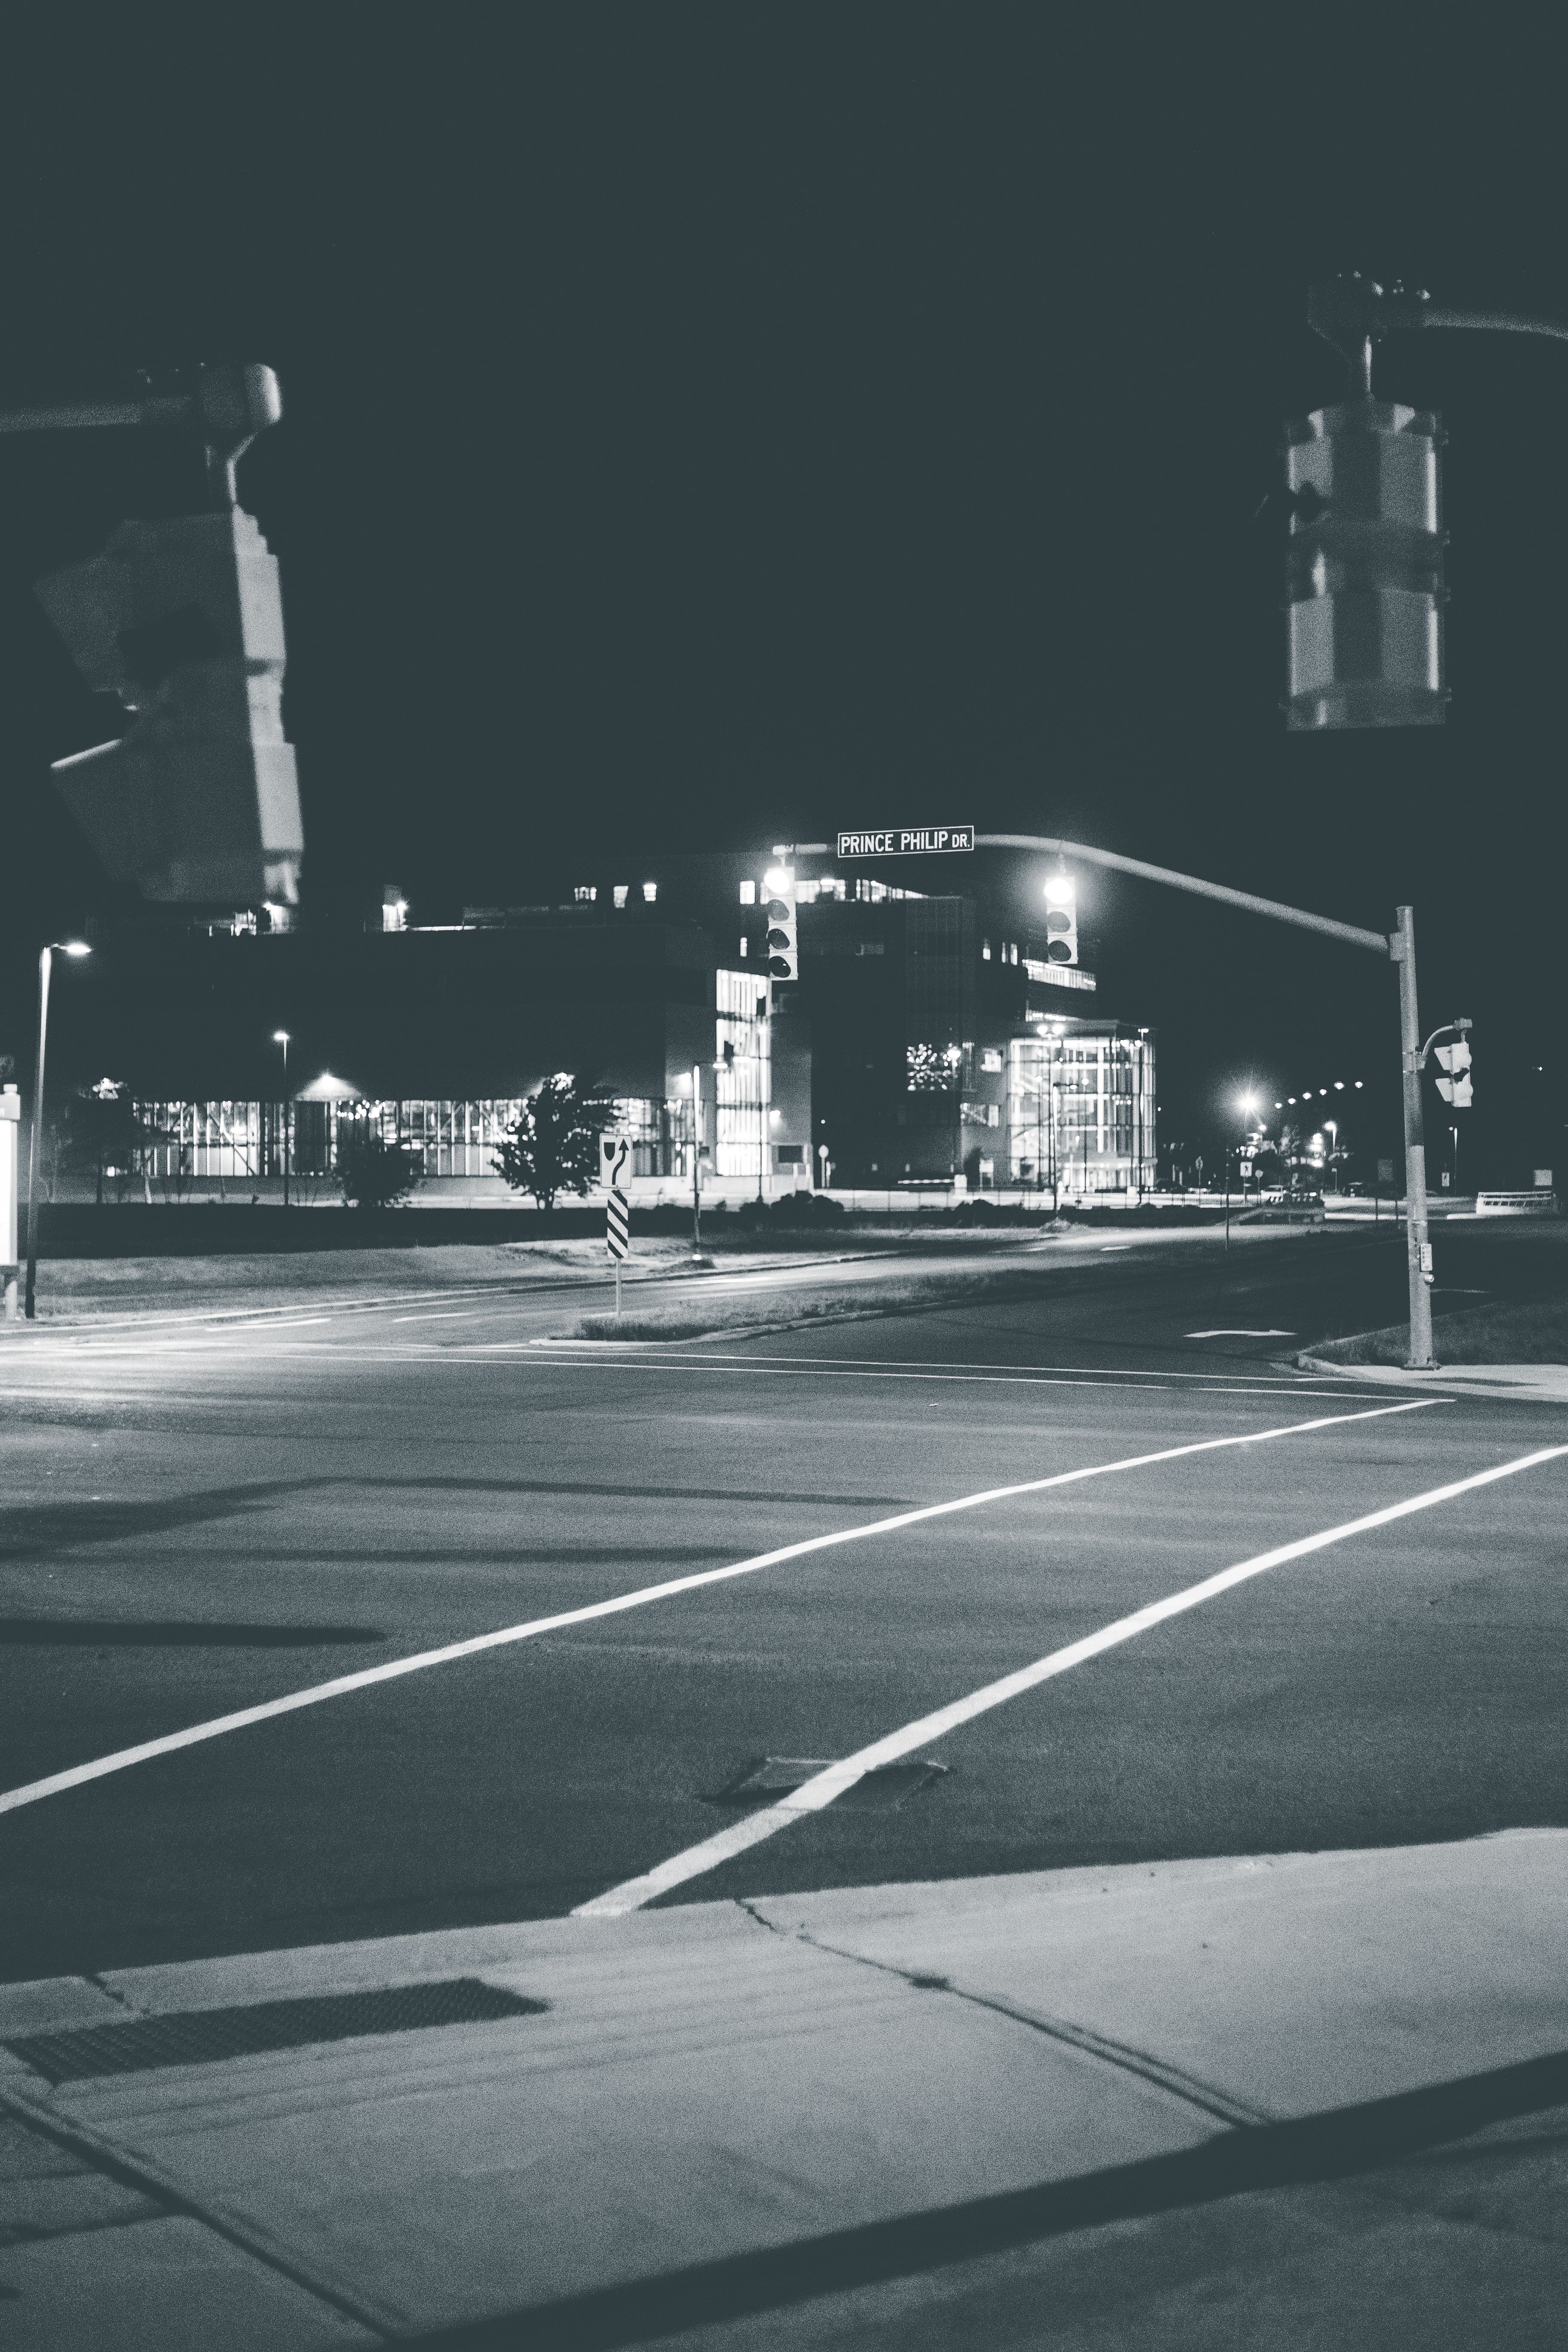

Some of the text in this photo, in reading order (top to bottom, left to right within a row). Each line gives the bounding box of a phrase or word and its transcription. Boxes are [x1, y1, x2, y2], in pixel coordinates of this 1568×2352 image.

[841, 831, 970, 854] PRINCE PHILIP DR.
